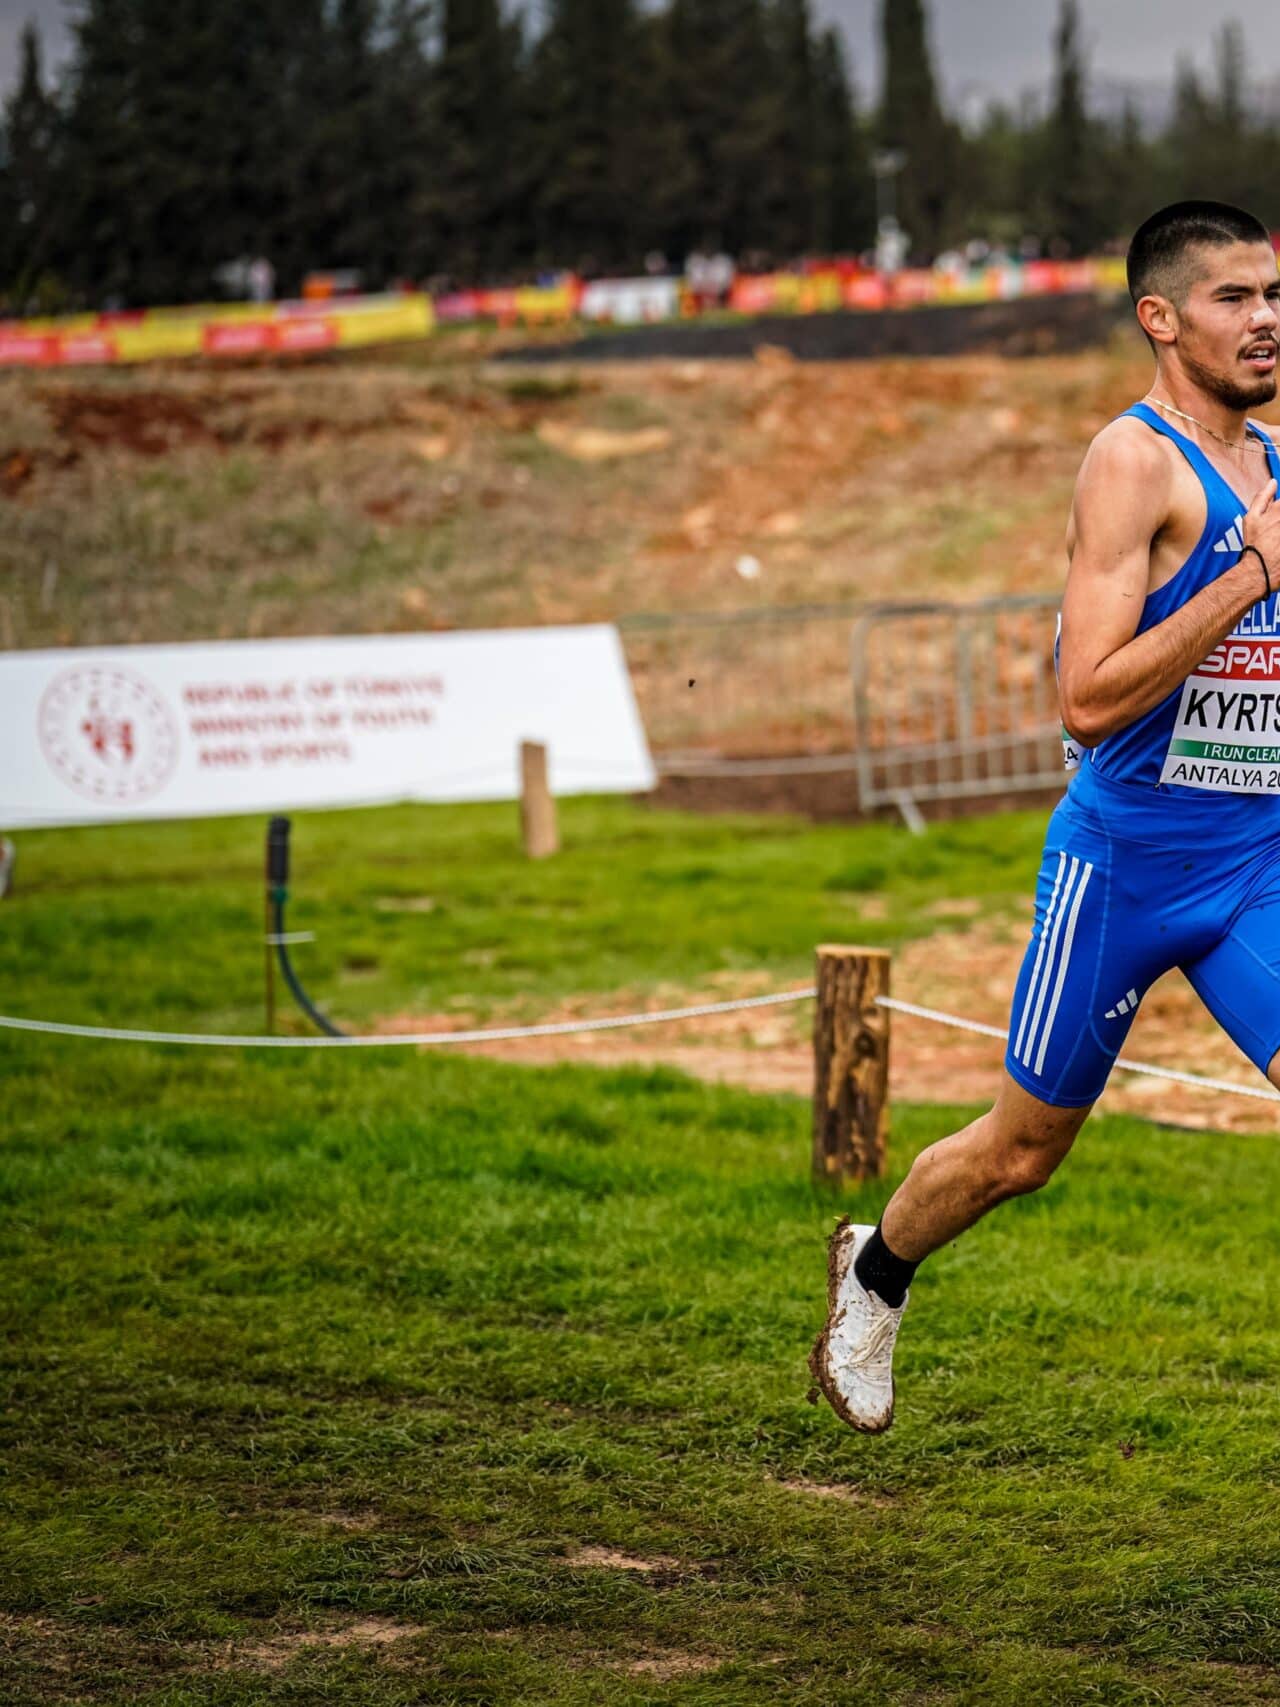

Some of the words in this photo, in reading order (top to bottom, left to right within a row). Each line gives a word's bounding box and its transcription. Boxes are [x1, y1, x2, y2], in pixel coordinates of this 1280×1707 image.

[1203, 743, 1209, 757] I
[1212, 744, 1244, 759] RUN
[1171, 763, 1262, 788] ANTALYA
